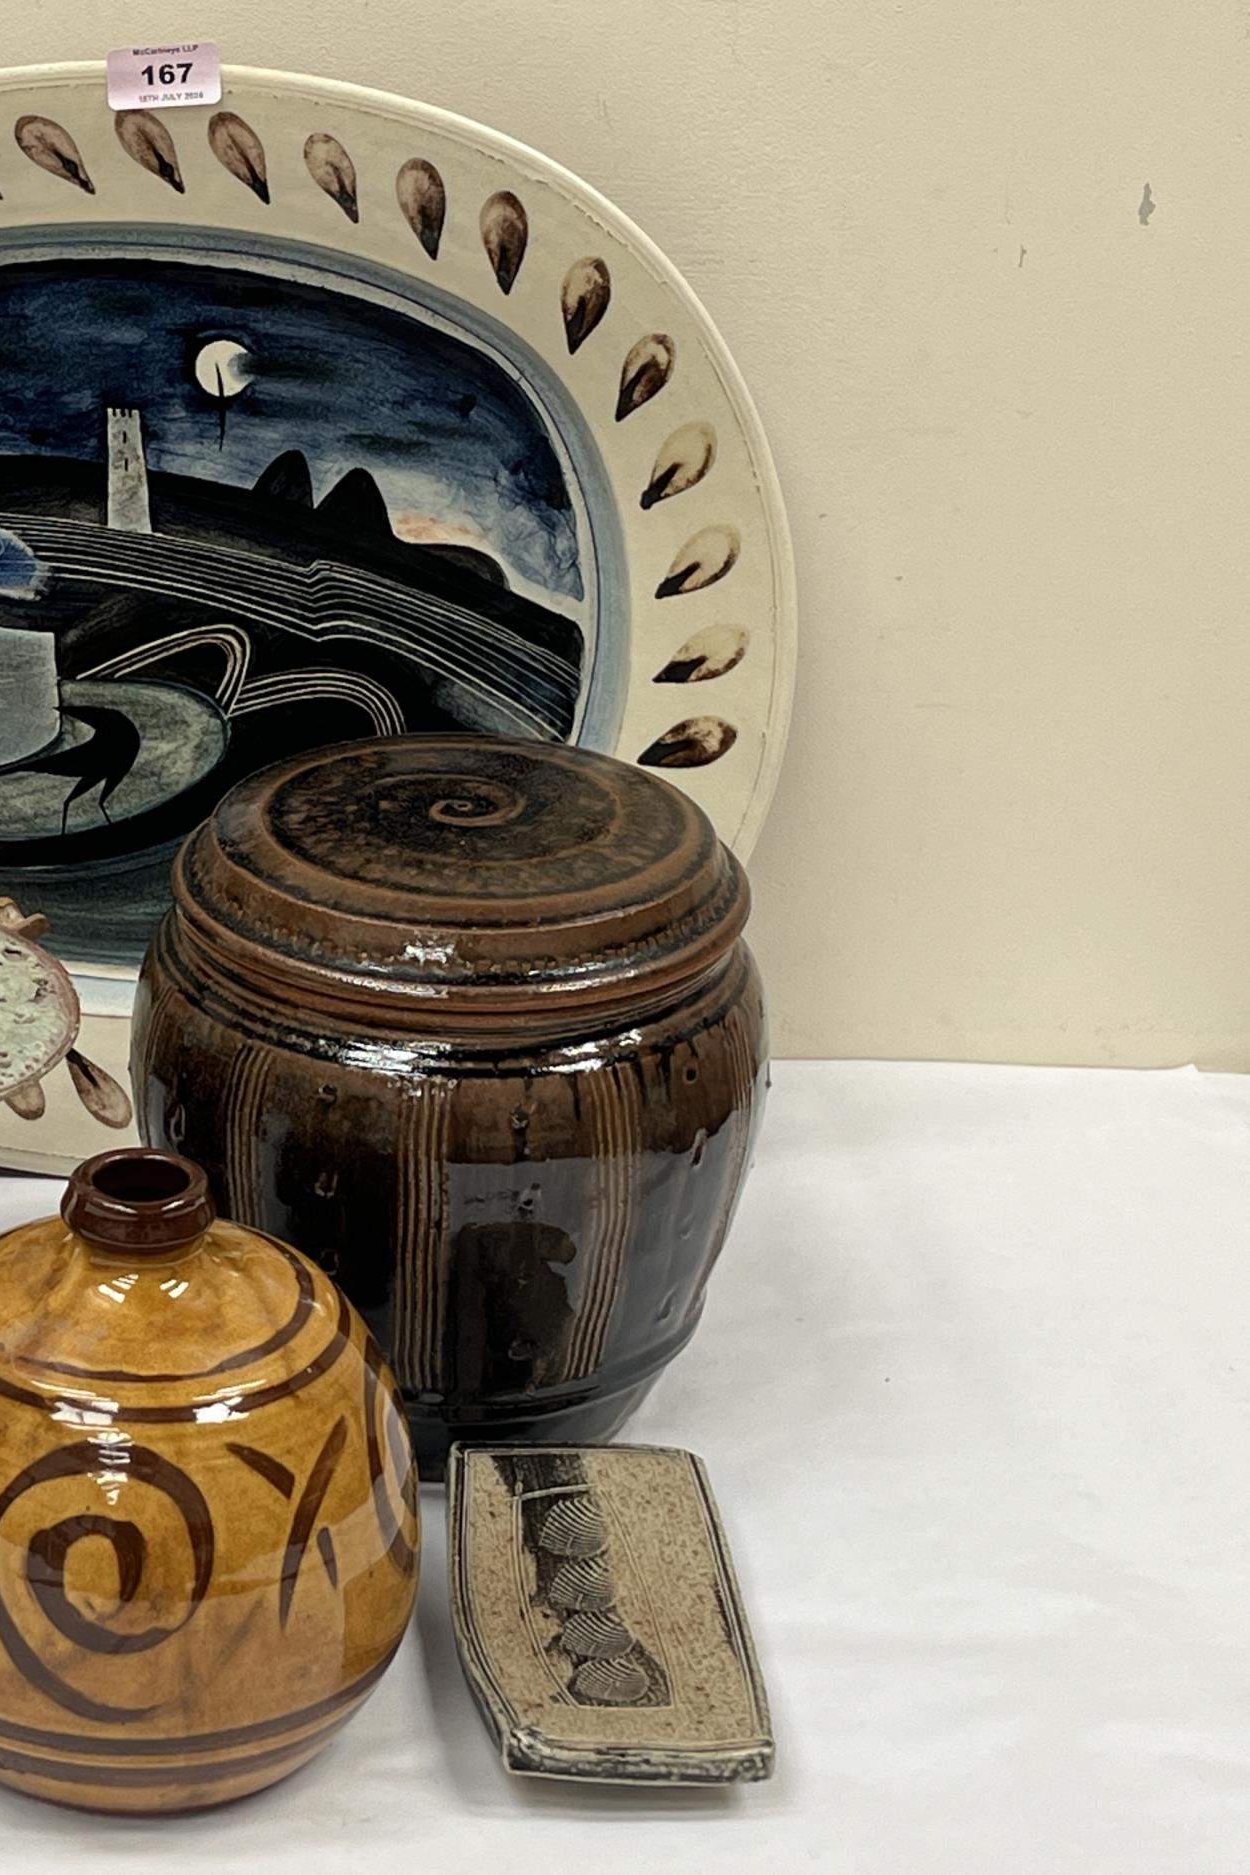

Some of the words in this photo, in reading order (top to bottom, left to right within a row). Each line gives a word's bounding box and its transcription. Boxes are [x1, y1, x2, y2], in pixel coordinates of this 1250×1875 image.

[182, 44, 199, 52] LLP
[141, 63, 193, 85] 167
[161, 92, 182, 101] JULY
